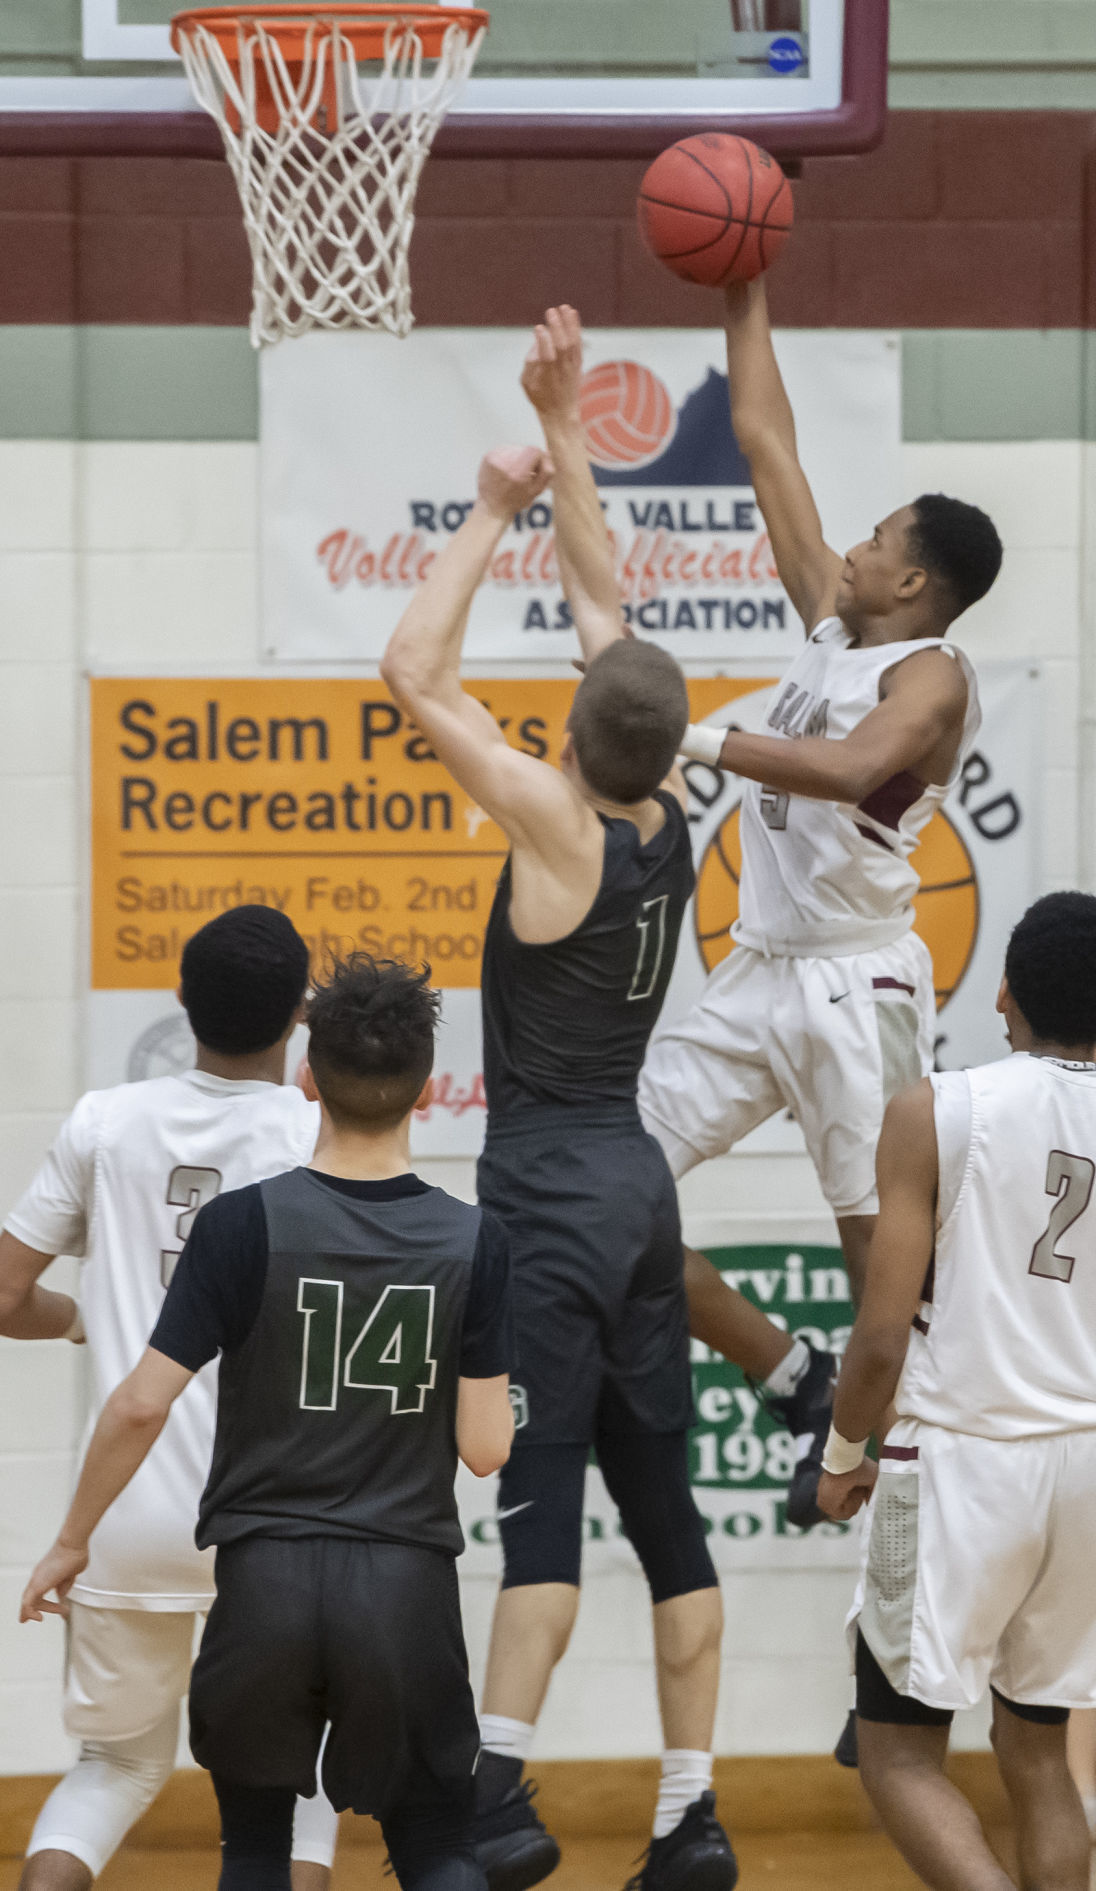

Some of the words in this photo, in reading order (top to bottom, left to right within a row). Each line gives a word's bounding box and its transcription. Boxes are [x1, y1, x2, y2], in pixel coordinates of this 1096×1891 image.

[629, 501, 757, 531] VALLE
[316, 528, 557, 584] Volleall
[523, 599, 786, 631] ASCIATION
[118, 699, 329, 763] Salem
[361, 700, 549, 764] Pas
[120, 775, 454, 832] Recreation
[115, 875, 293, 914] Saturday
[305, 876, 391, 912] Feb.
[405, 876, 478, 912] 2nd
[115, 924, 180, 963] Sal
[356, 924, 482, 960] Schoo
[627, 894, 670, 1001] 1
[160, 1164, 223, 1290] 3
[1028, 1149, 1096, 1284] 2
[719, 1252, 851, 1303] rvin
[296, 1276, 438, 1415] 14
[692, 1430, 796, 1482] 198
